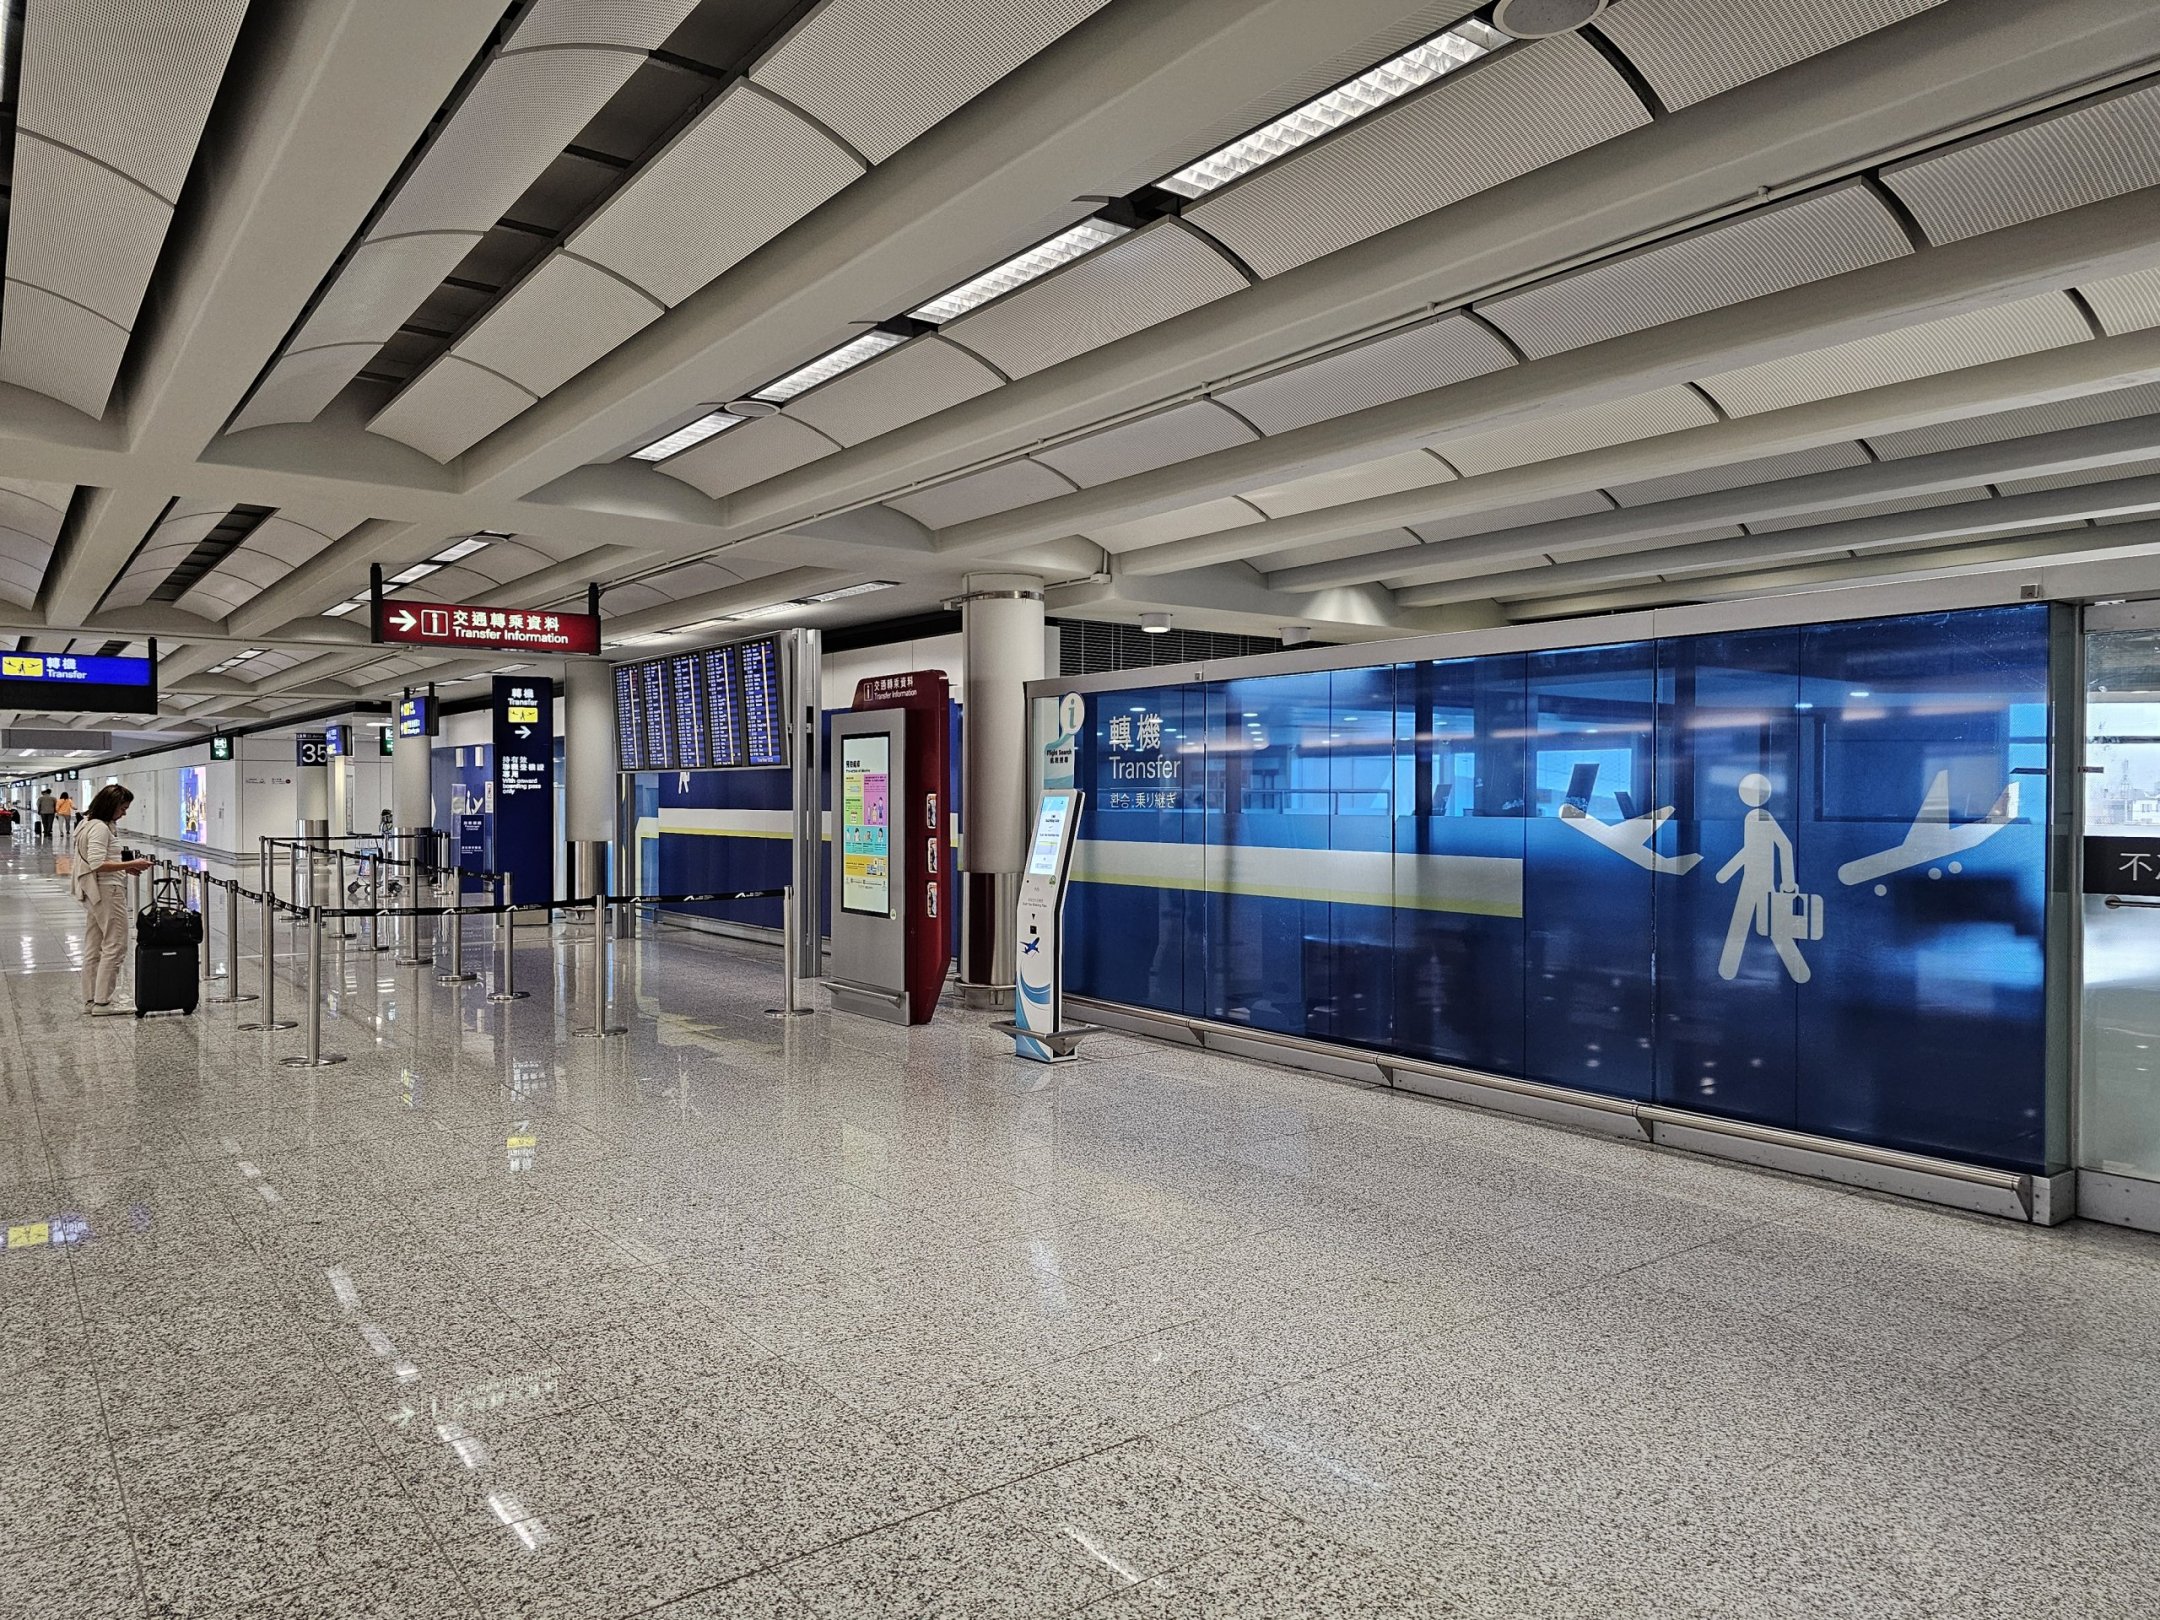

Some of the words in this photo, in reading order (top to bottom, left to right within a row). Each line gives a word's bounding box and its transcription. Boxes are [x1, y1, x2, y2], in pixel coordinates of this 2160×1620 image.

[452, 609, 560, 632] 交通轉乘資料
[453, 626, 501, 640] Transfer
[504, 630, 569, 644] Information
[46, 656, 77, 670] 轉機
[46, 668, 88, 679] Transfer
[507, 697, 538, 706] Transfer
[874, 691, 891, 700] Transfer
[891, 688, 917, 698] Information
[1108, 713, 1162, 751] 轉機
[302, 743, 327, 763] 35
[1058, 748, 1072, 756] Search
[1108, 754, 1181, 780] Transfer
[2118, 852, 2160, 881] 不
